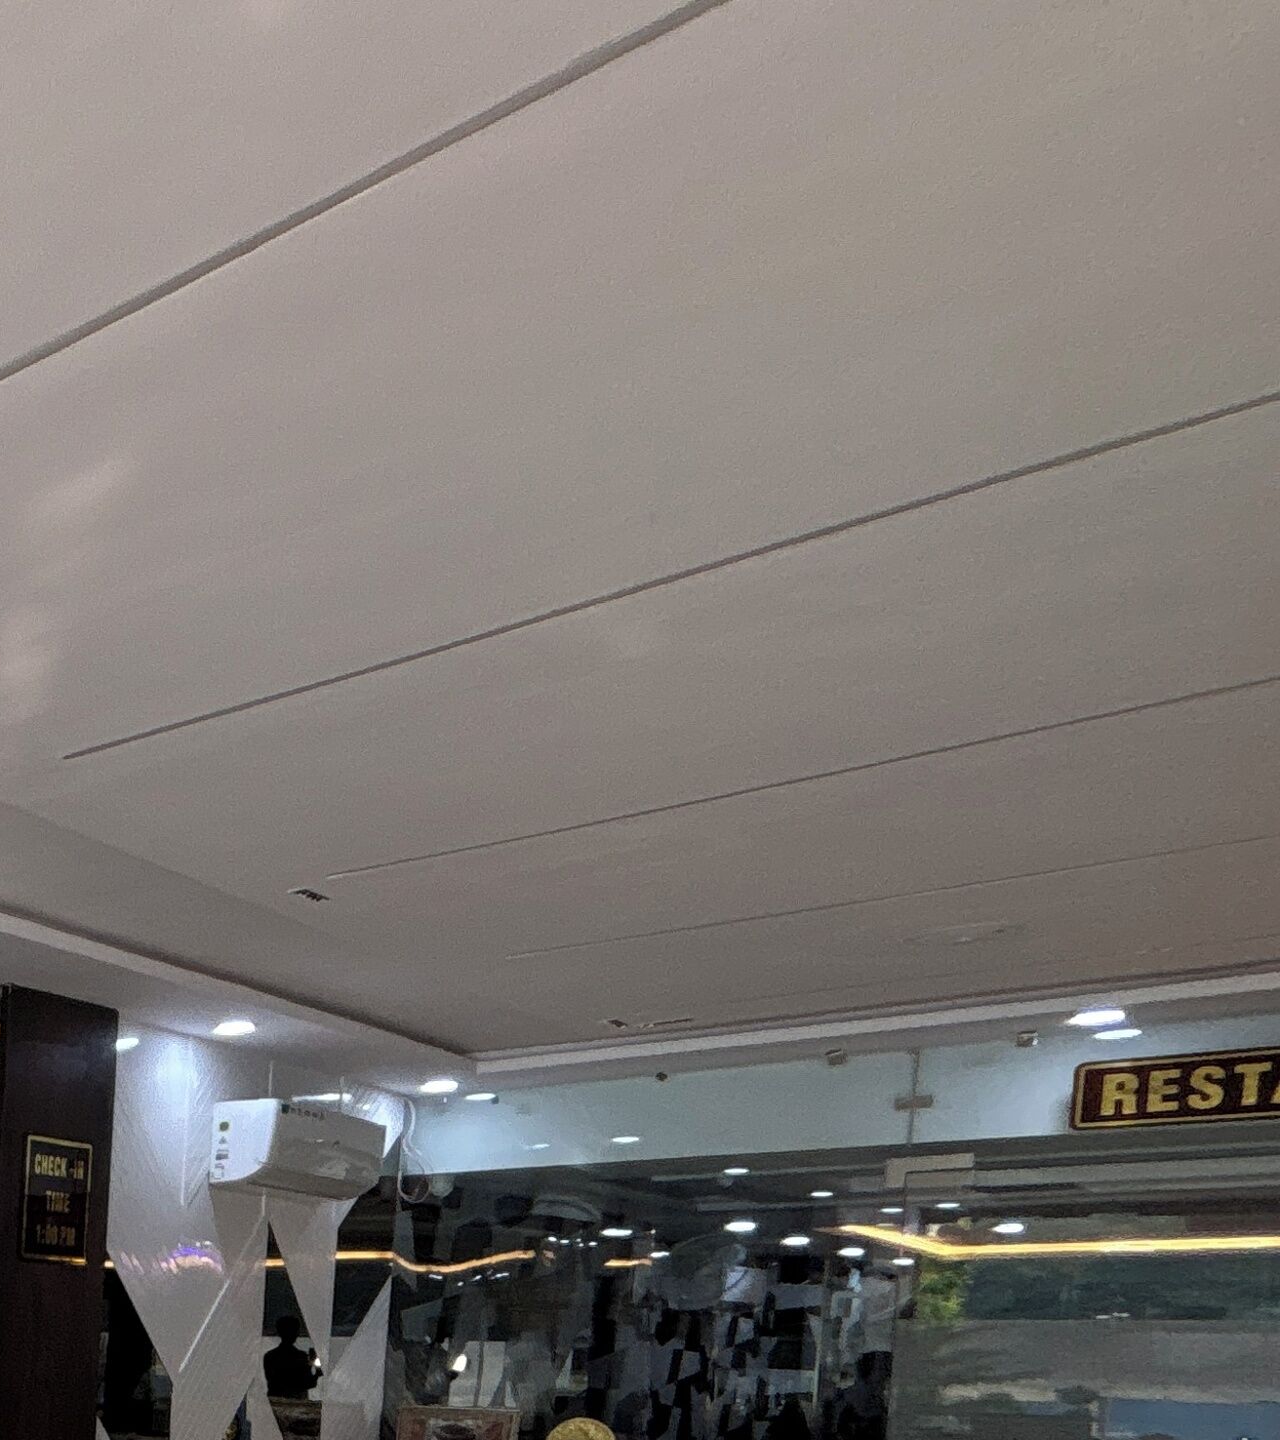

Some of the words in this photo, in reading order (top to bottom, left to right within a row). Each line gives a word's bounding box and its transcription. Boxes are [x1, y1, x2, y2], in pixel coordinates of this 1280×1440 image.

[1099, 1061, 1280, 1116] REST
[34, 1152, 68, 1178] CHECK
[45, 1189, 71, 1214] TIME
